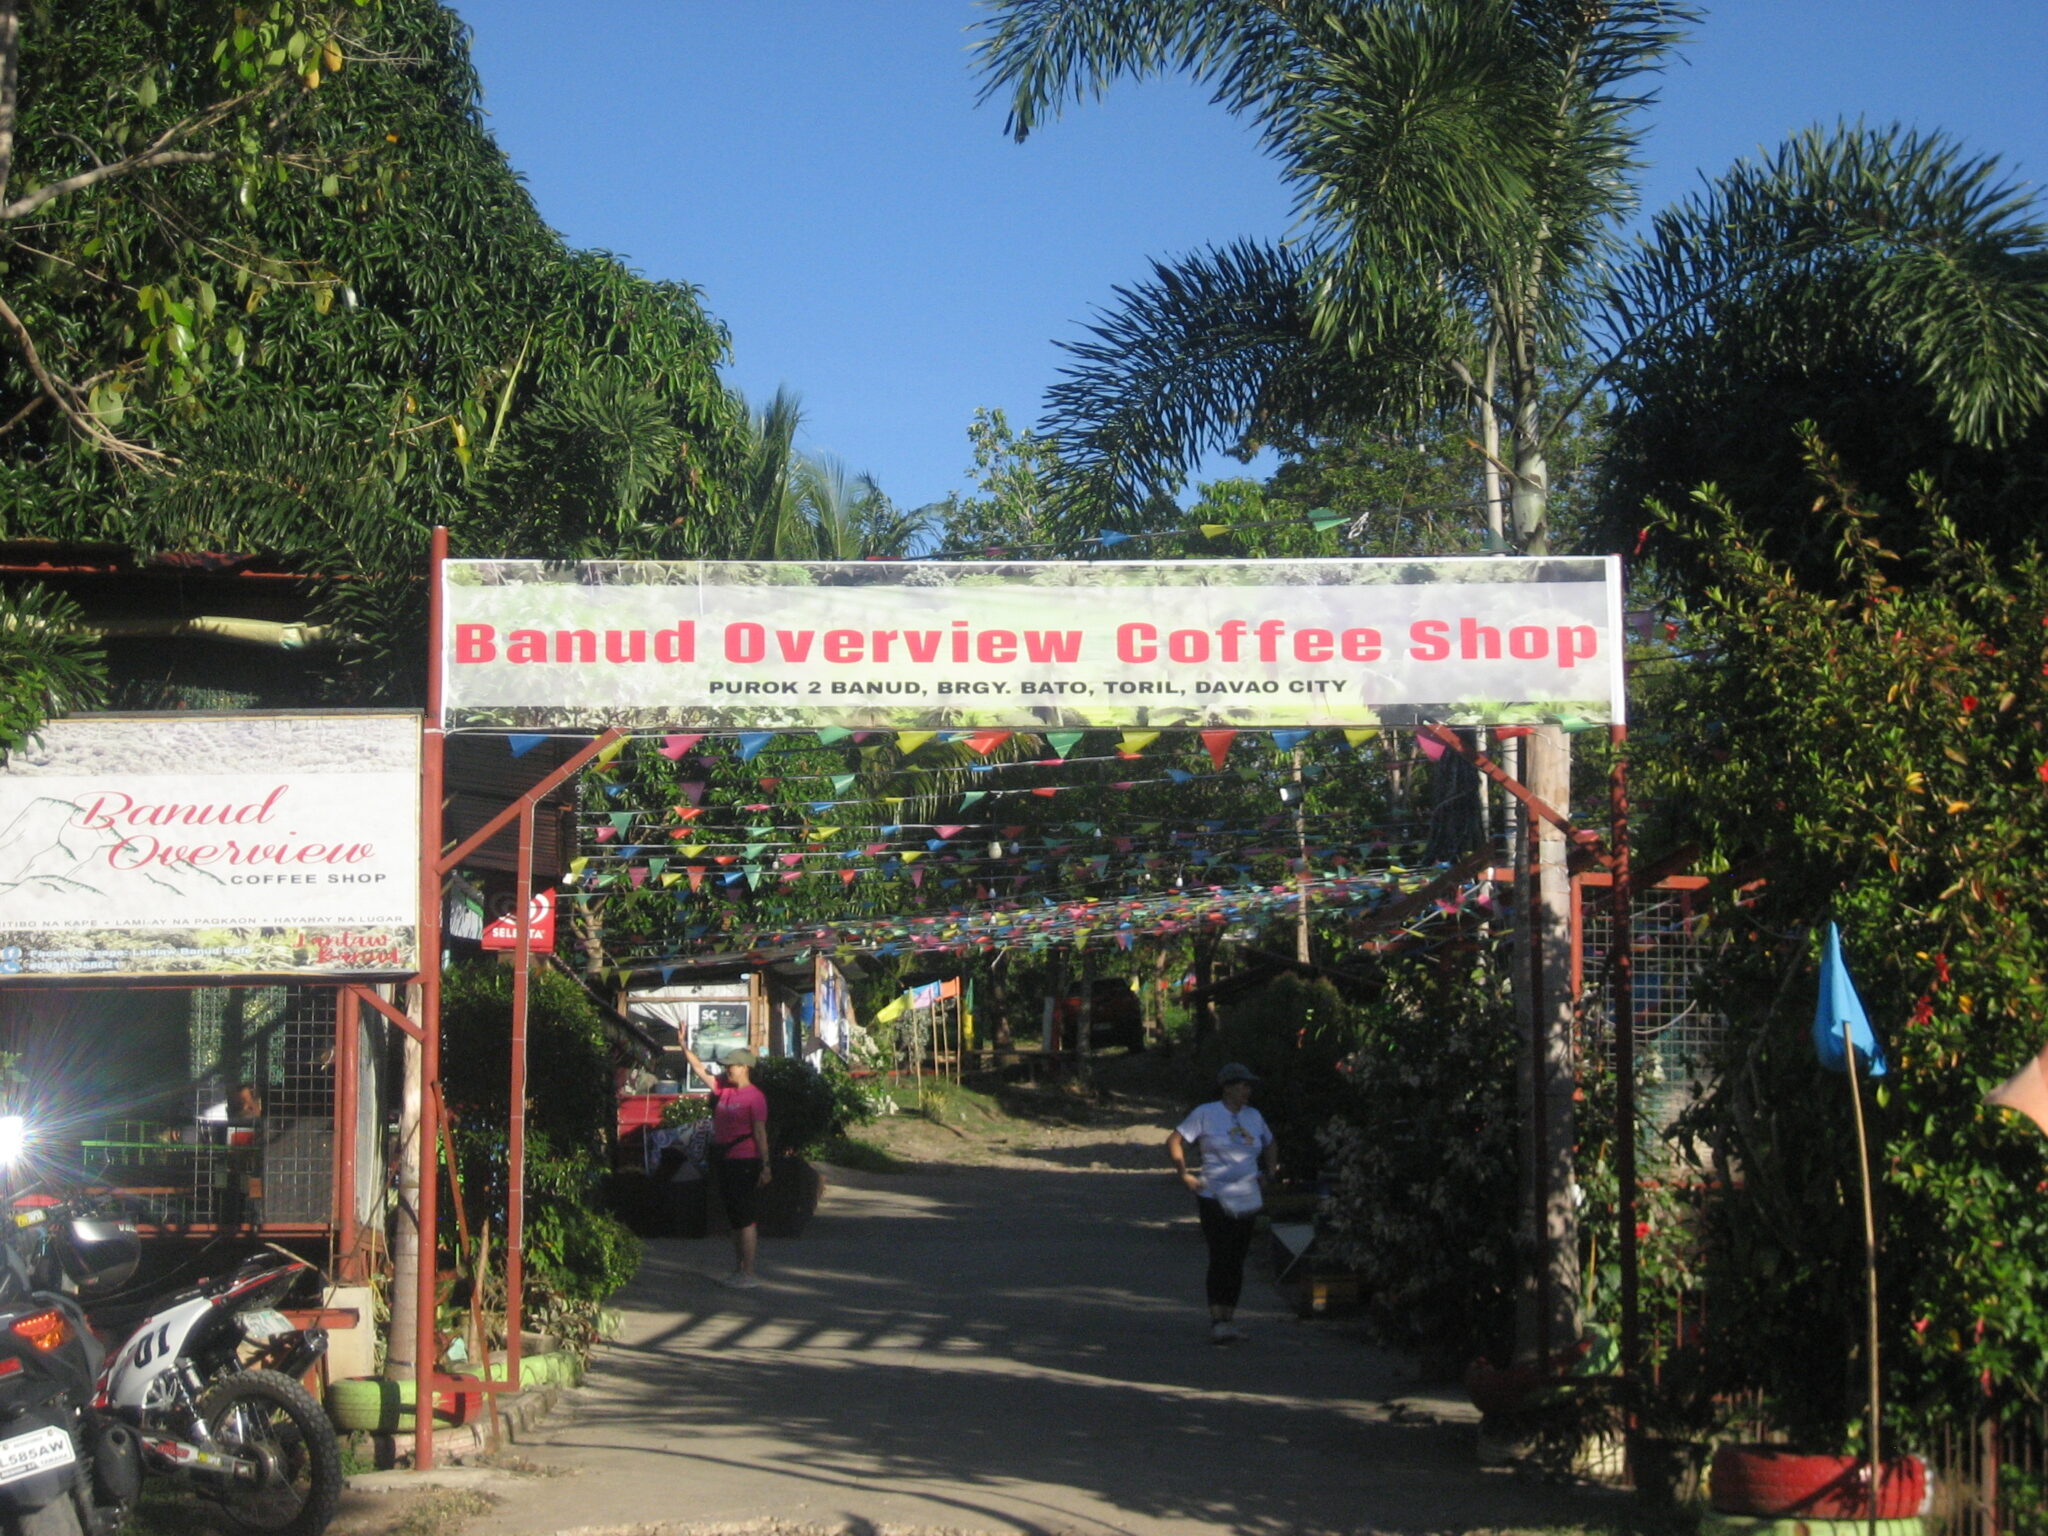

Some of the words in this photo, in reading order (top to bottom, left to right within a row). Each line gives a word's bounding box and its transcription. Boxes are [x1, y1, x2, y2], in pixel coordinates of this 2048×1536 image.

[455, 620, 696, 664] Banud
[723, 620, 1083, 664] Overview
[1116, 619, 1382, 664] Coffee
[1409, 617, 1598, 668] Shop
[708, 680, 798, 695] PUROK
[807, 681, 822, 695] 2
[830, 681, 928, 698] BANUD,
[937, 681, 1013, 695] BRGY.
[1022, 680, 1094, 698] BATO,
[1103, 680, 1187, 697] TORIL,
[1195, 680, 1280, 695] DAVAO
[1288, 679, 1347, 694] CITY
[70, 784, 289, 830] Banud
[108, 831, 376, 870] Overview
[230, 874, 317, 886] COFFEE
[327, 873, 388, 885] SHOP
[42, 920, 59, 928] NA
[64, 919, 98, 927] KAPE
[173, 918, 191, 926] NA
[359, 915, 403, 923] LUGAR
[492, 927, 544, 939] SELETA
